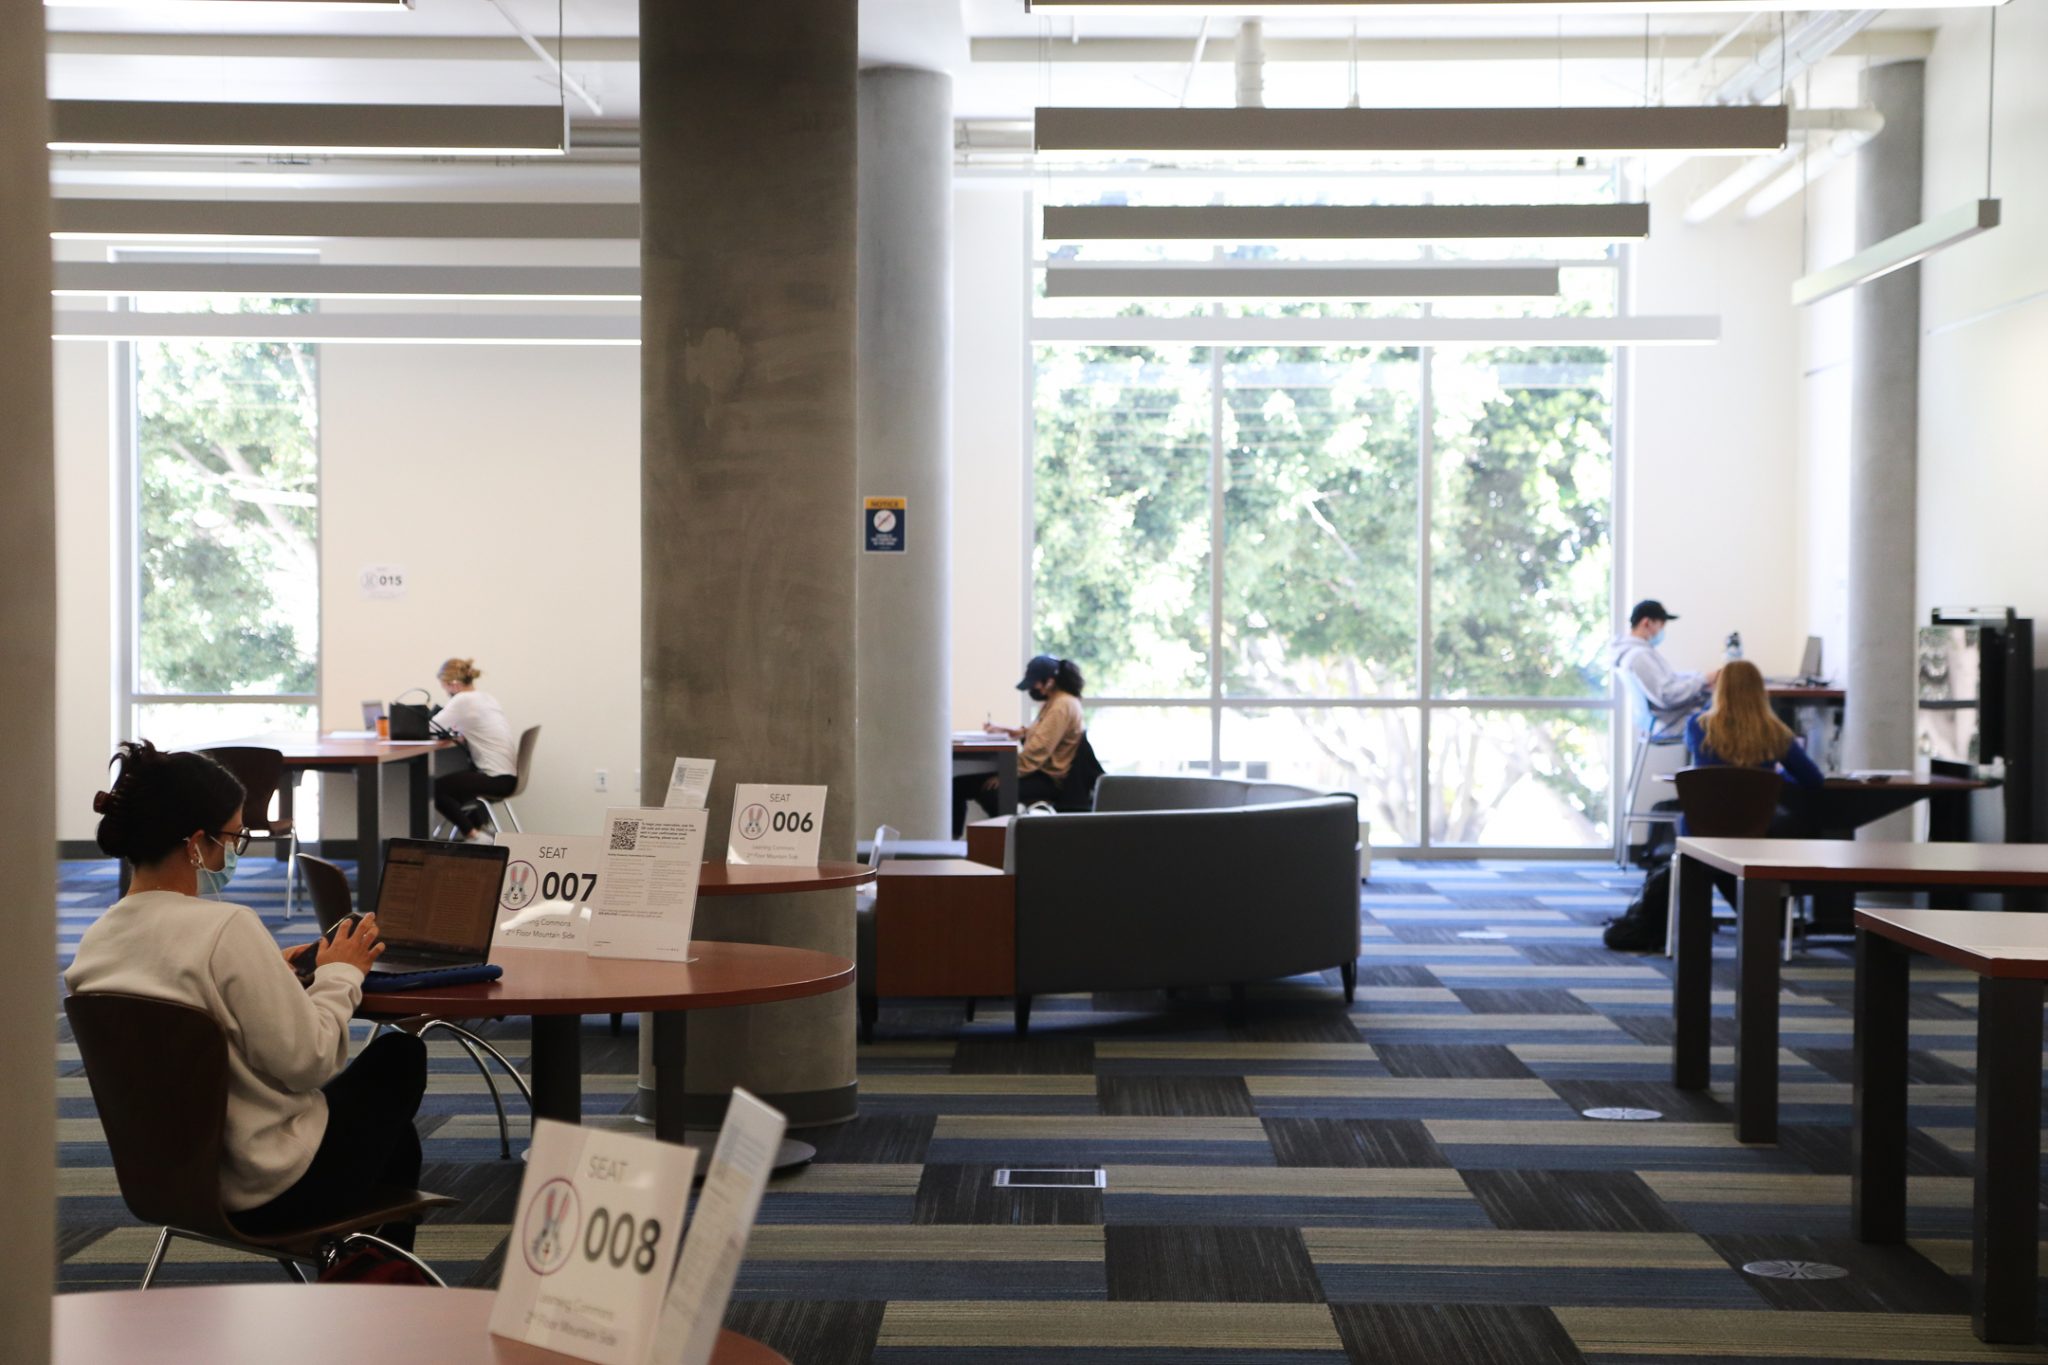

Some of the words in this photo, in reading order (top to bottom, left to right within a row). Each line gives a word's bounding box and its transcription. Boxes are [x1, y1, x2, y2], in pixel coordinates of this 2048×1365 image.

[379, 575, 402, 586] 015
[769, 793, 791, 802] SEAT
[773, 811, 813, 832] 006
[538, 846, 568, 859] SEAT
[542, 871, 597, 902] 007
[541, 918, 571, 927] Commons
[516, 929, 532, 937] Floor
[587, 1155, 628, 1181] SEAT
[584, 1206, 661, 1275] 008
